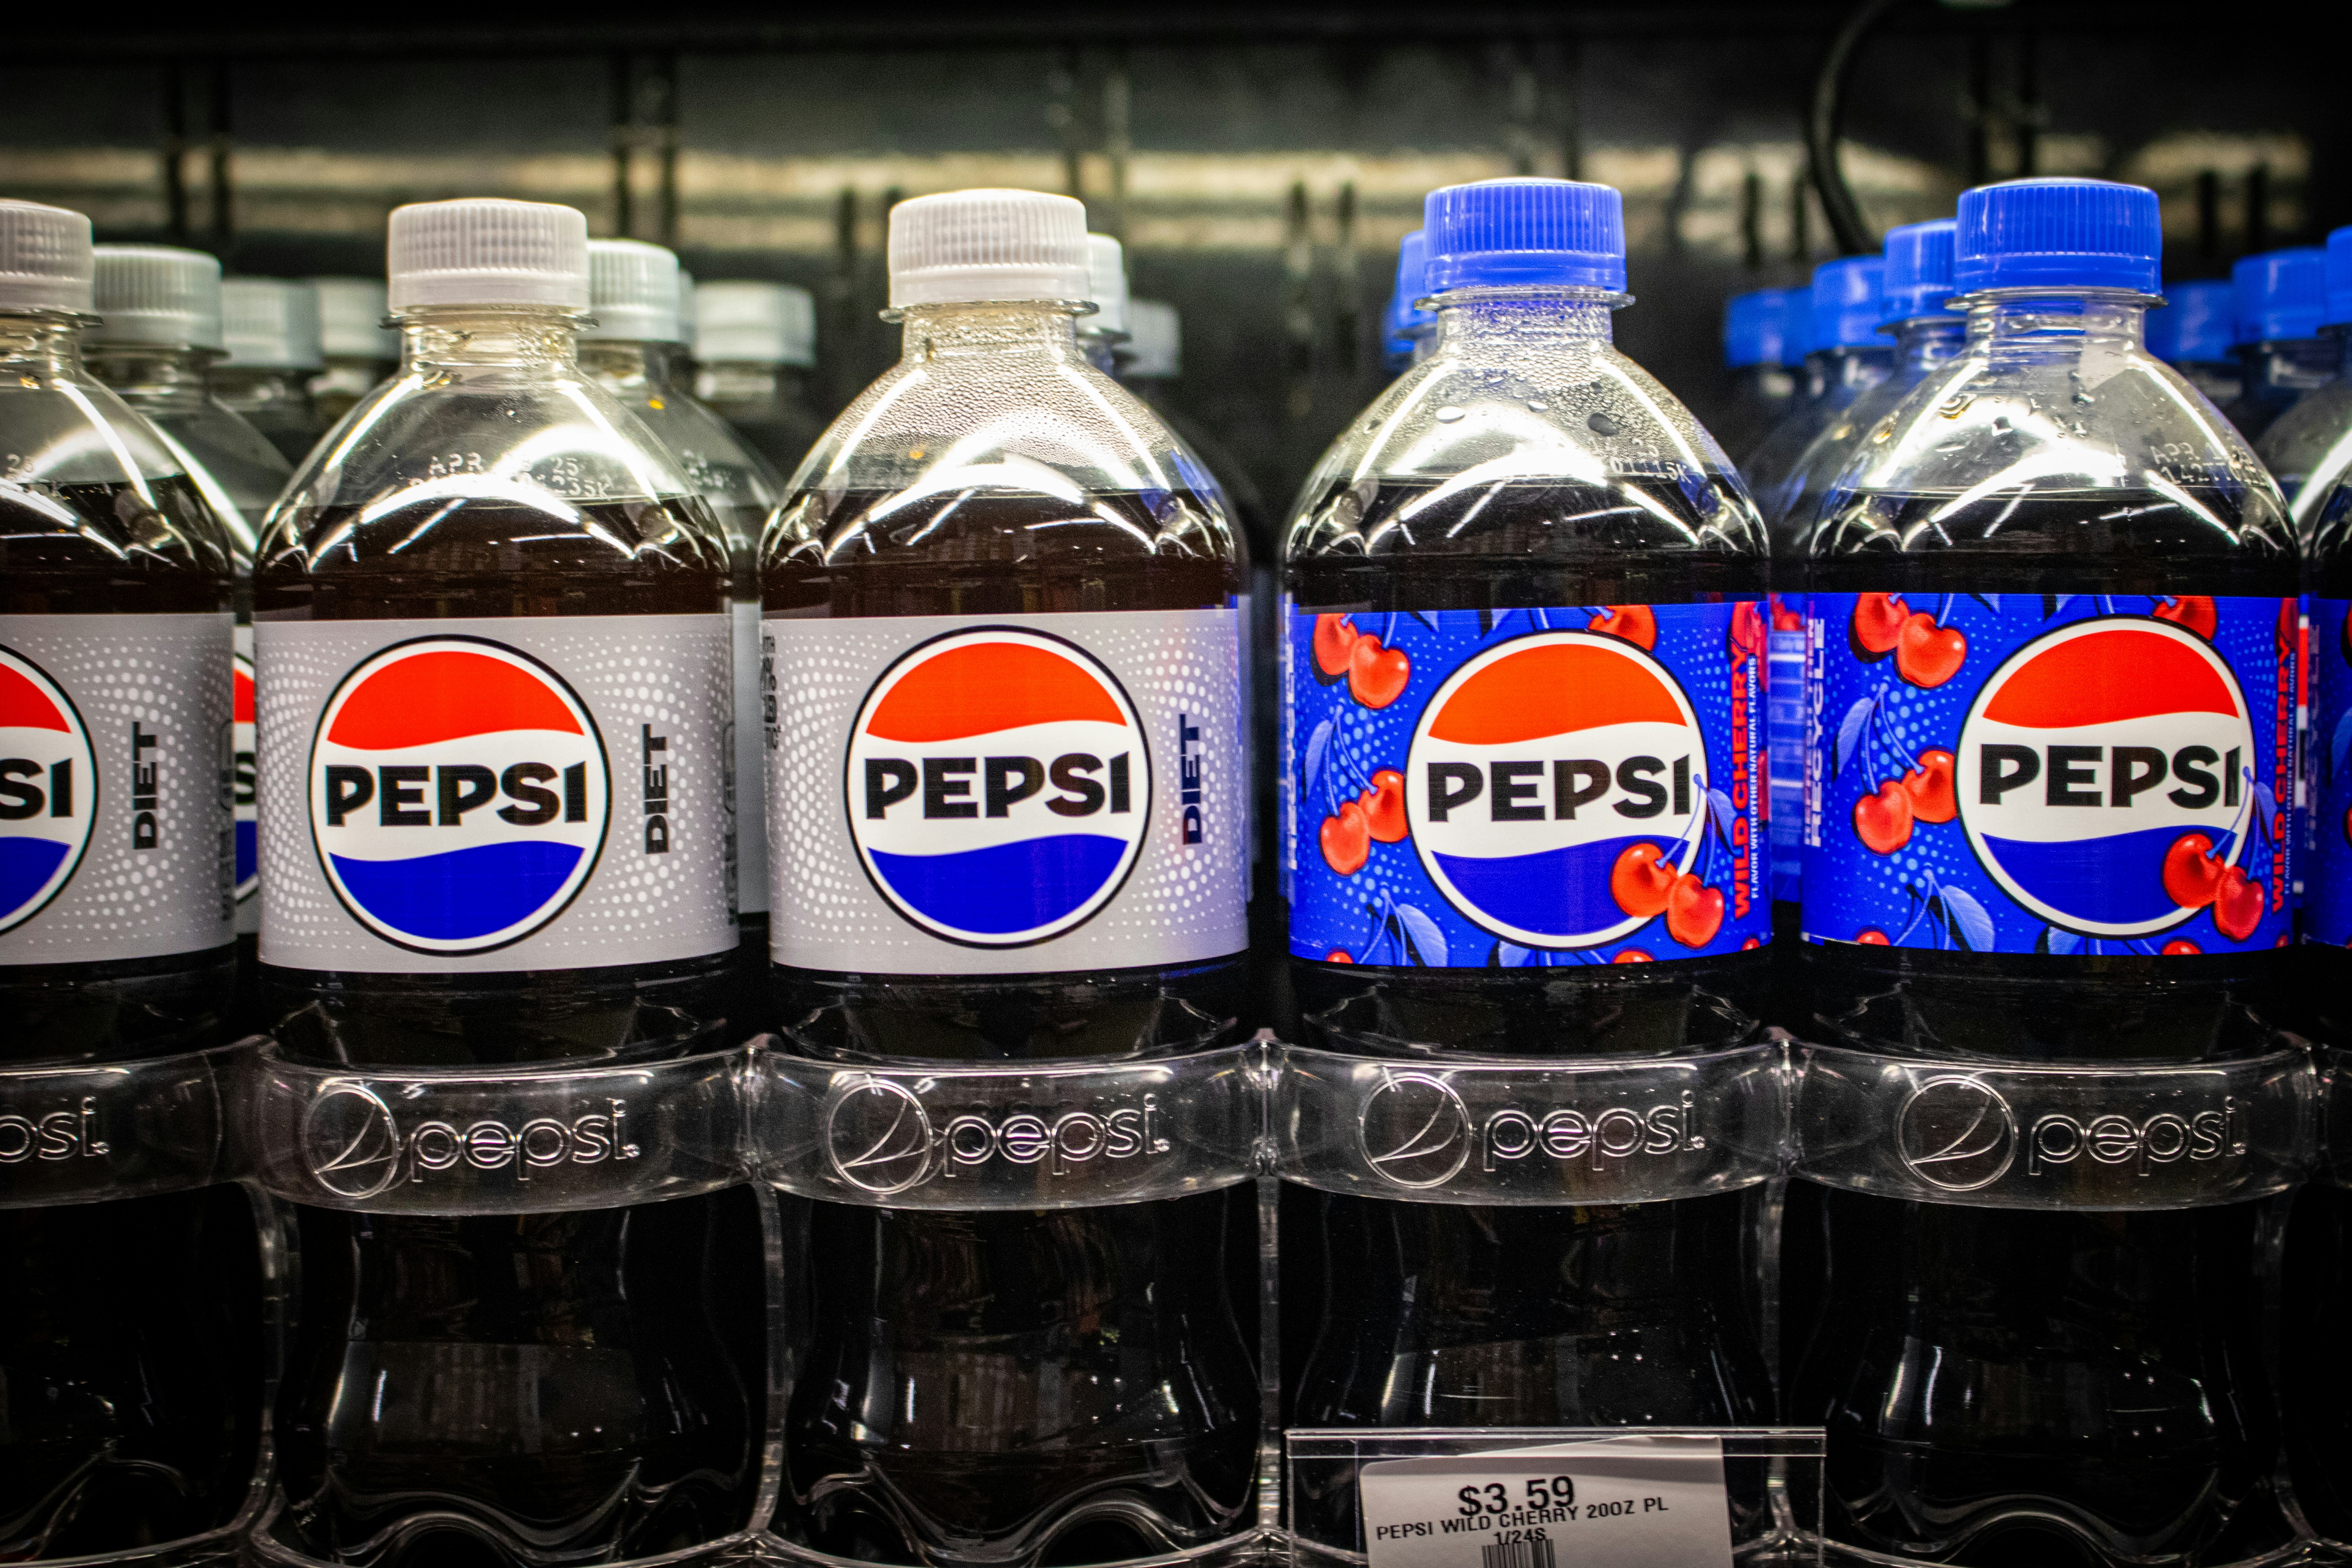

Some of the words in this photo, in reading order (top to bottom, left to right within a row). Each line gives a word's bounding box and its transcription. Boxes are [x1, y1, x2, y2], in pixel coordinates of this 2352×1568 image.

[1730, 643, 1748, 810] CHERRY
[1748, 715, 1757, 772] NATURAL
[2275, 635, 2290, 803] CHERRY
[132, 721, 158, 850] DIET
[325, 760, 587, 827] PEPSI
[642, 724, 669, 855] DIET
[865, 751, 1131, 820] PEPSI
[1179, 713, 1202, 845] DIET
[1426, 753, 1691, 822] PEPSI
[1749, 775, 1758, 815] OTHER
[1980, 743, 2242, 809] PEPSI
[1731, 817, 1751, 920] WILD
[1750, 818, 1759, 850] WITH
[2272, 813, 2286, 913] WILD
[1376, 1521, 1434, 1540] PEPSI
[1440, 1515, 1491, 1534] WILD
[1499, 1505, 1578, 1528] CHERRY
[1643, 1497, 1669, 1513] PL
[1457, 1475, 1575, 1517] $3.59
[1494, 1527, 1546, 1545] 1/24S
